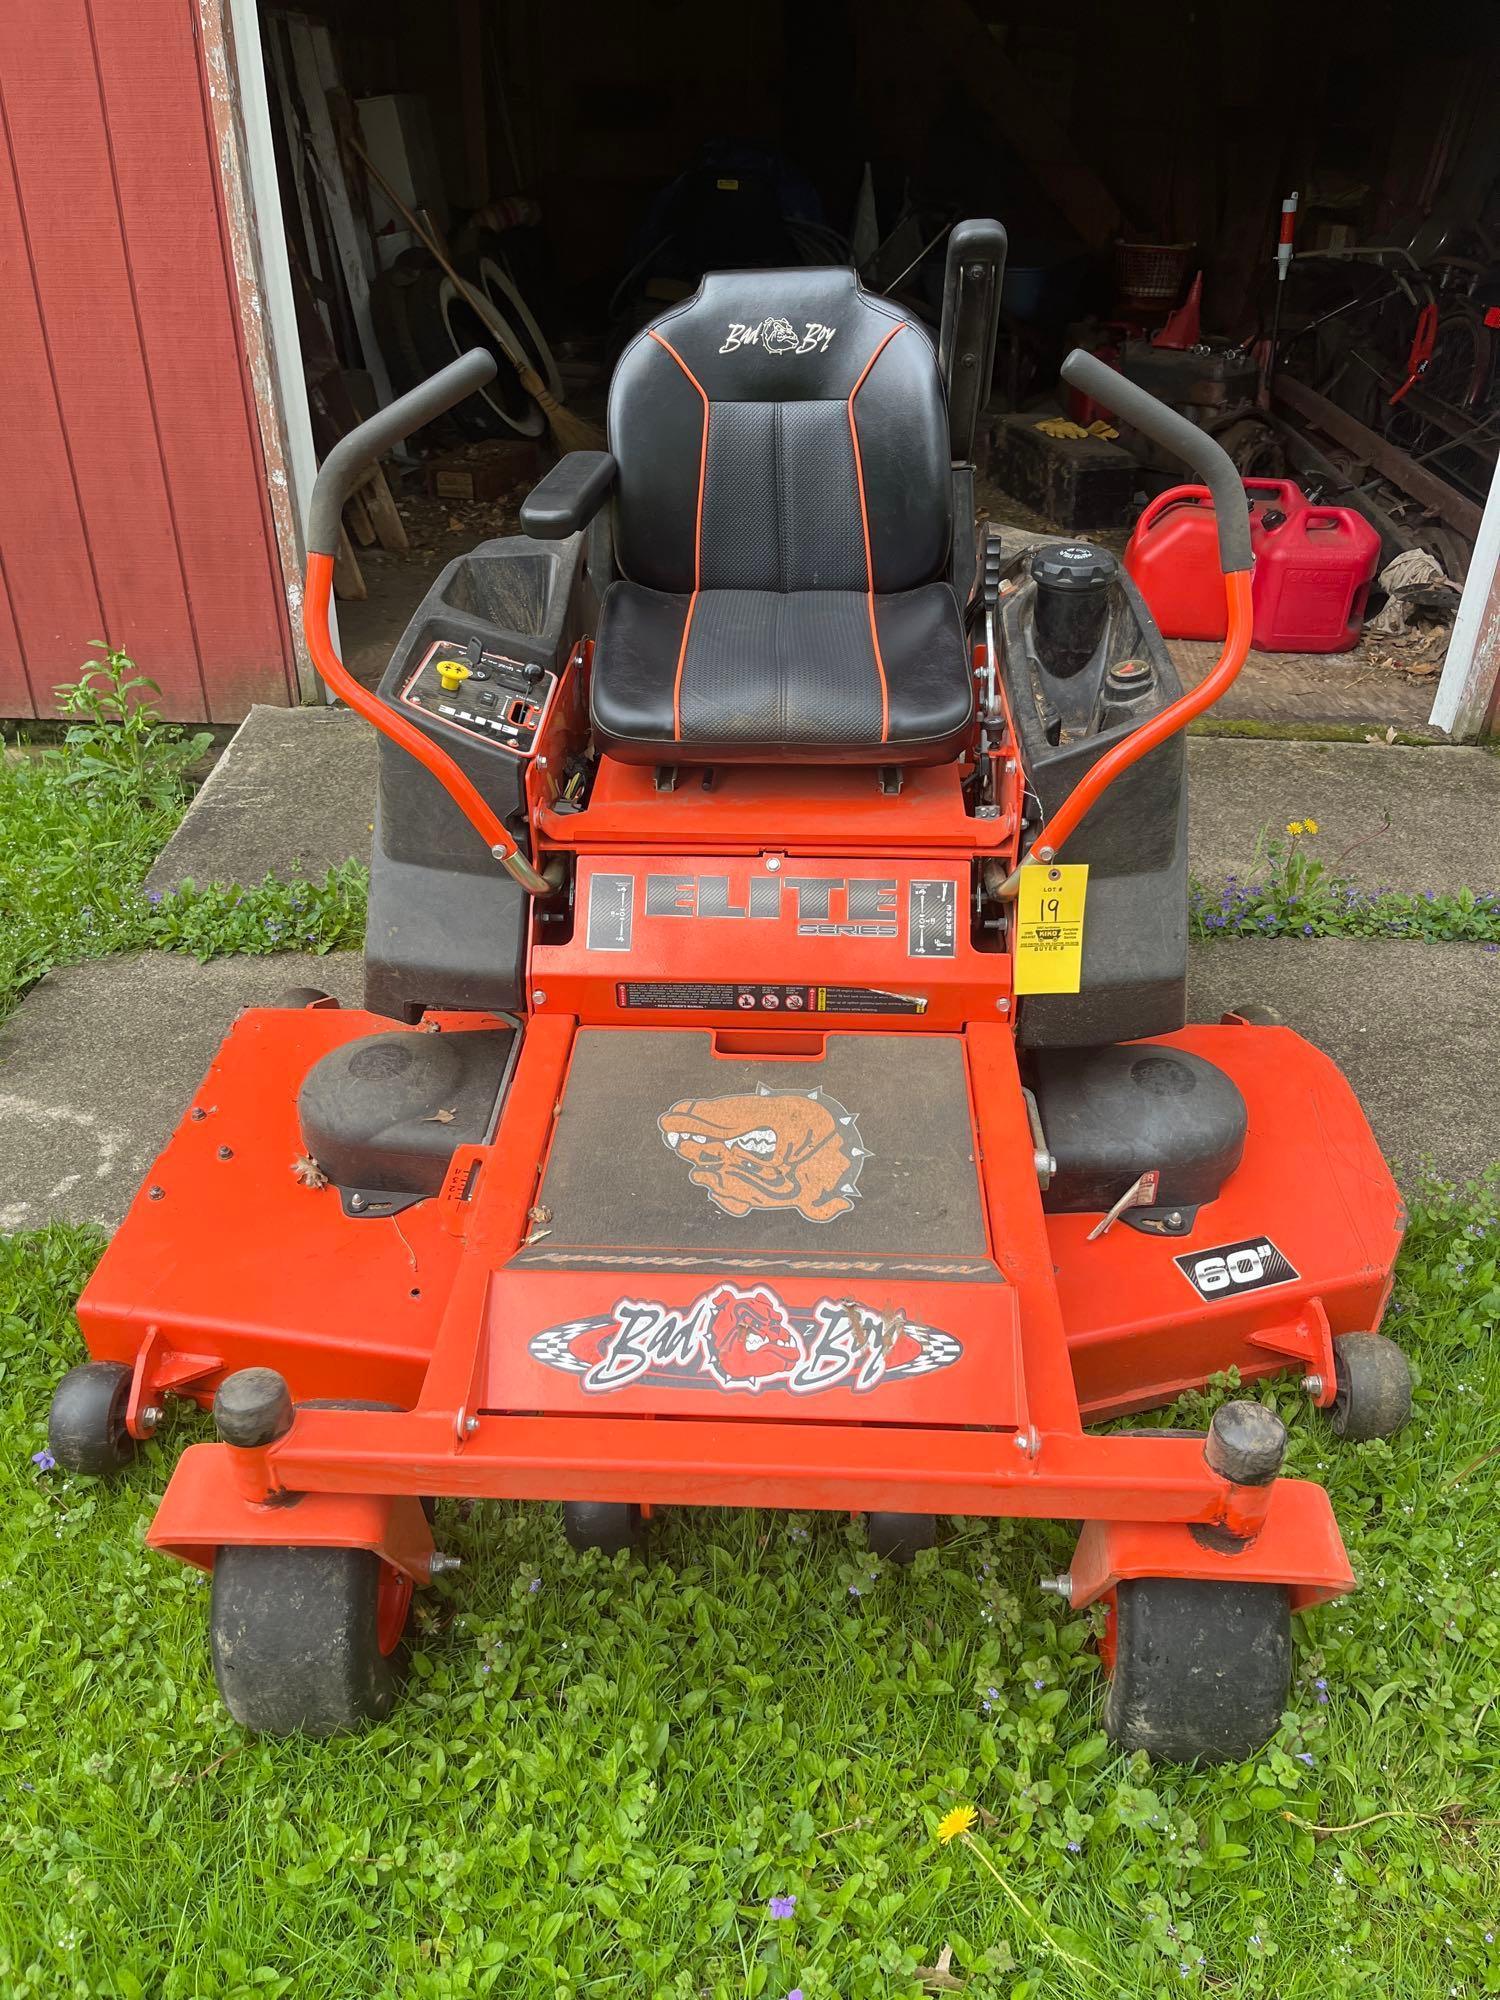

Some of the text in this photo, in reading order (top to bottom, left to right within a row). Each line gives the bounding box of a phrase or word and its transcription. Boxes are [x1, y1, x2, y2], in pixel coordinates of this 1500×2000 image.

[718, 321, 837, 354] Bad Boy
[438, 704, 519, 736] ELITE
[645, 873, 898, 921] ELITE
[1040, 899, 1059, 922] 19
[797, 922, 899, 937] SERIES
[1194, 1244, 1272, 1292] 60"
[586, 1300, 708, 1388] Bad
[791, 1302, 905, 1387] Boy
